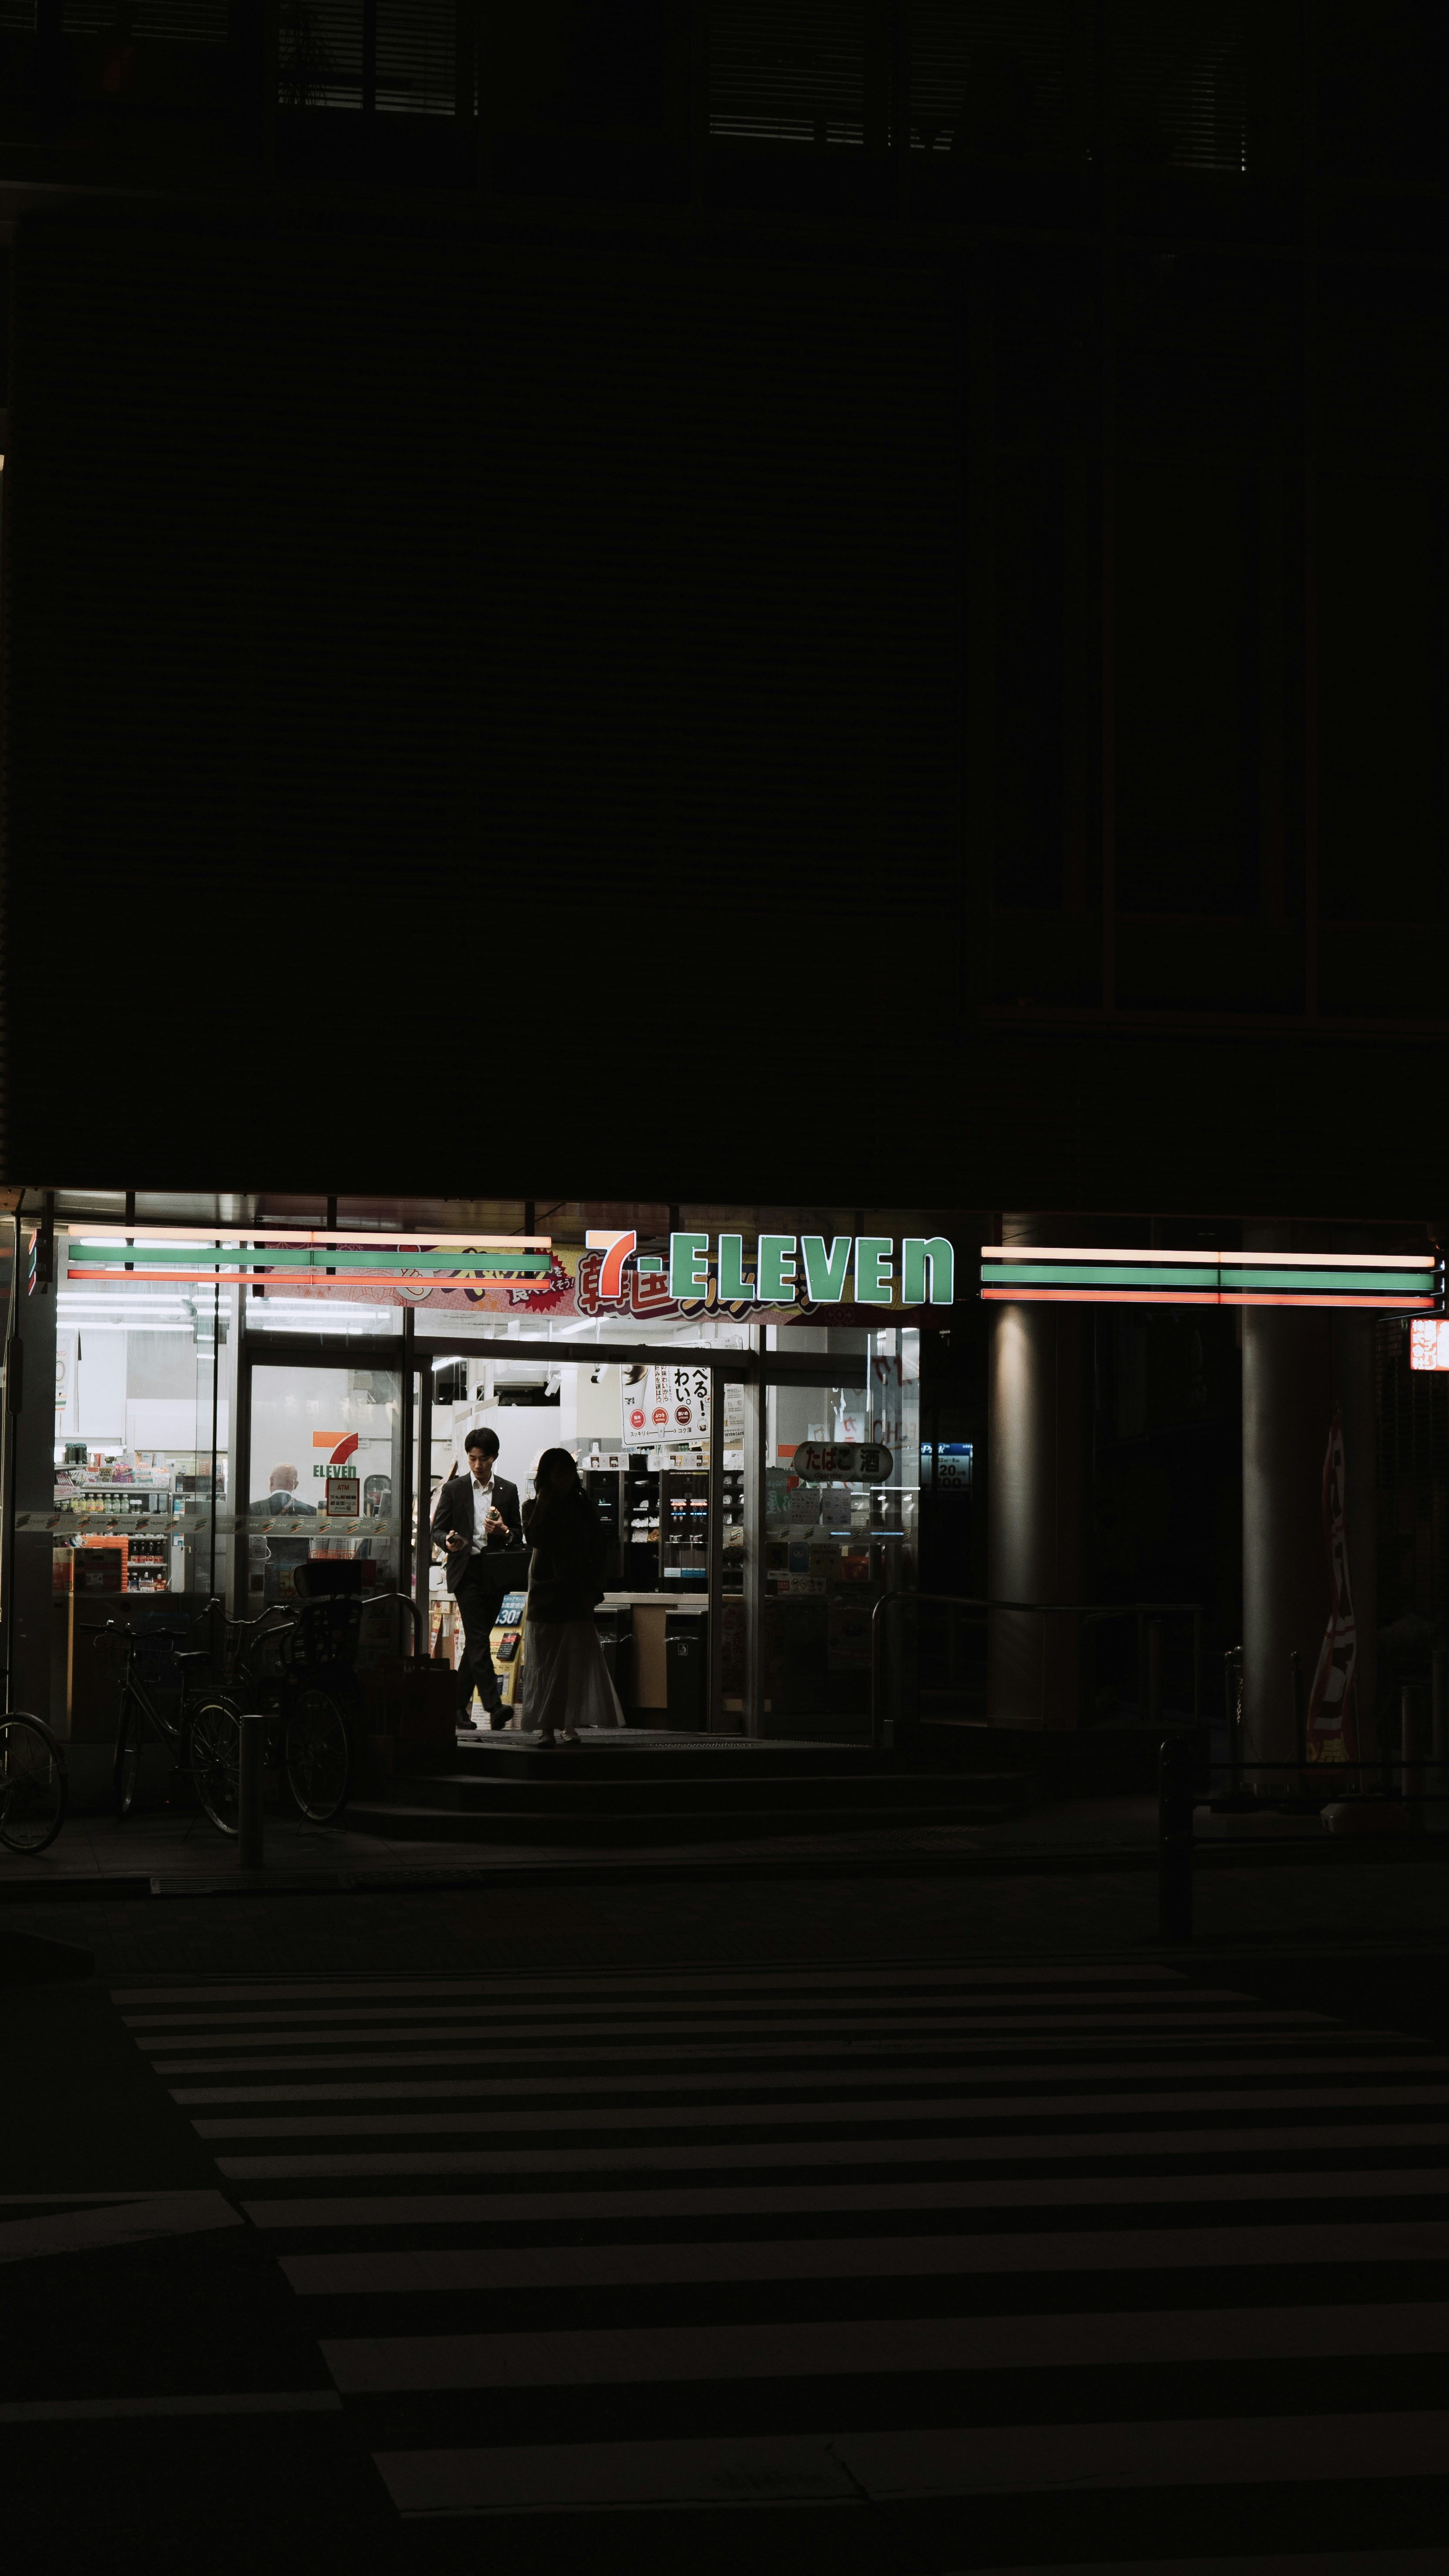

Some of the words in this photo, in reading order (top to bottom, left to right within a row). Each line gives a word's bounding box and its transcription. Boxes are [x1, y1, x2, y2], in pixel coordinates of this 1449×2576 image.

[806, 1446, 852, 1471] たばこ
[860, 1448, 880, 1473] 酒
[814, 1472, 842, 1480] cigarette
